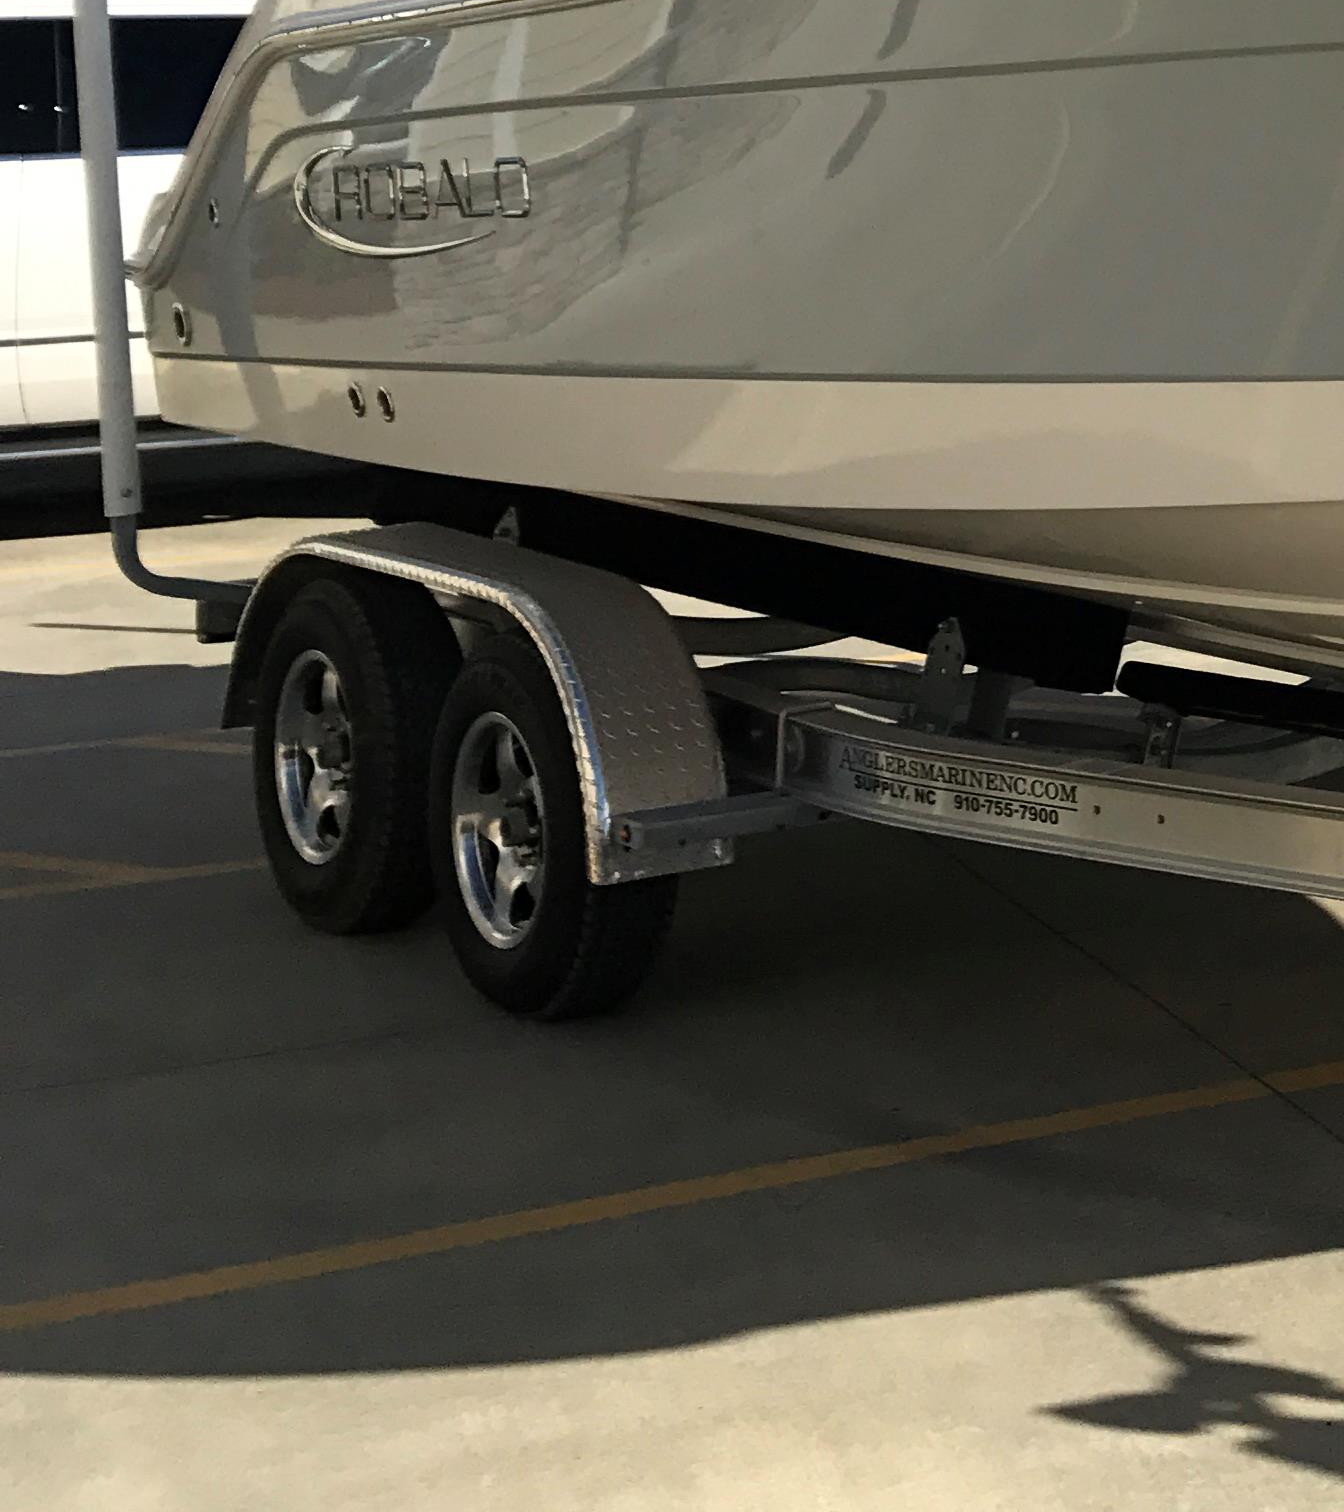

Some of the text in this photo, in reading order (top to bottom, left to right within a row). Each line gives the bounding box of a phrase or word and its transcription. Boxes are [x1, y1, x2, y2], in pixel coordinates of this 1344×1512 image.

[332, 156, 531, 221] ROBALO
[839, 745, 1078, 804] ANGLERSMARINENC.COM
[914, 788, 937, 806] NC
[953, 794, 1060, 825] 910-755-7900
